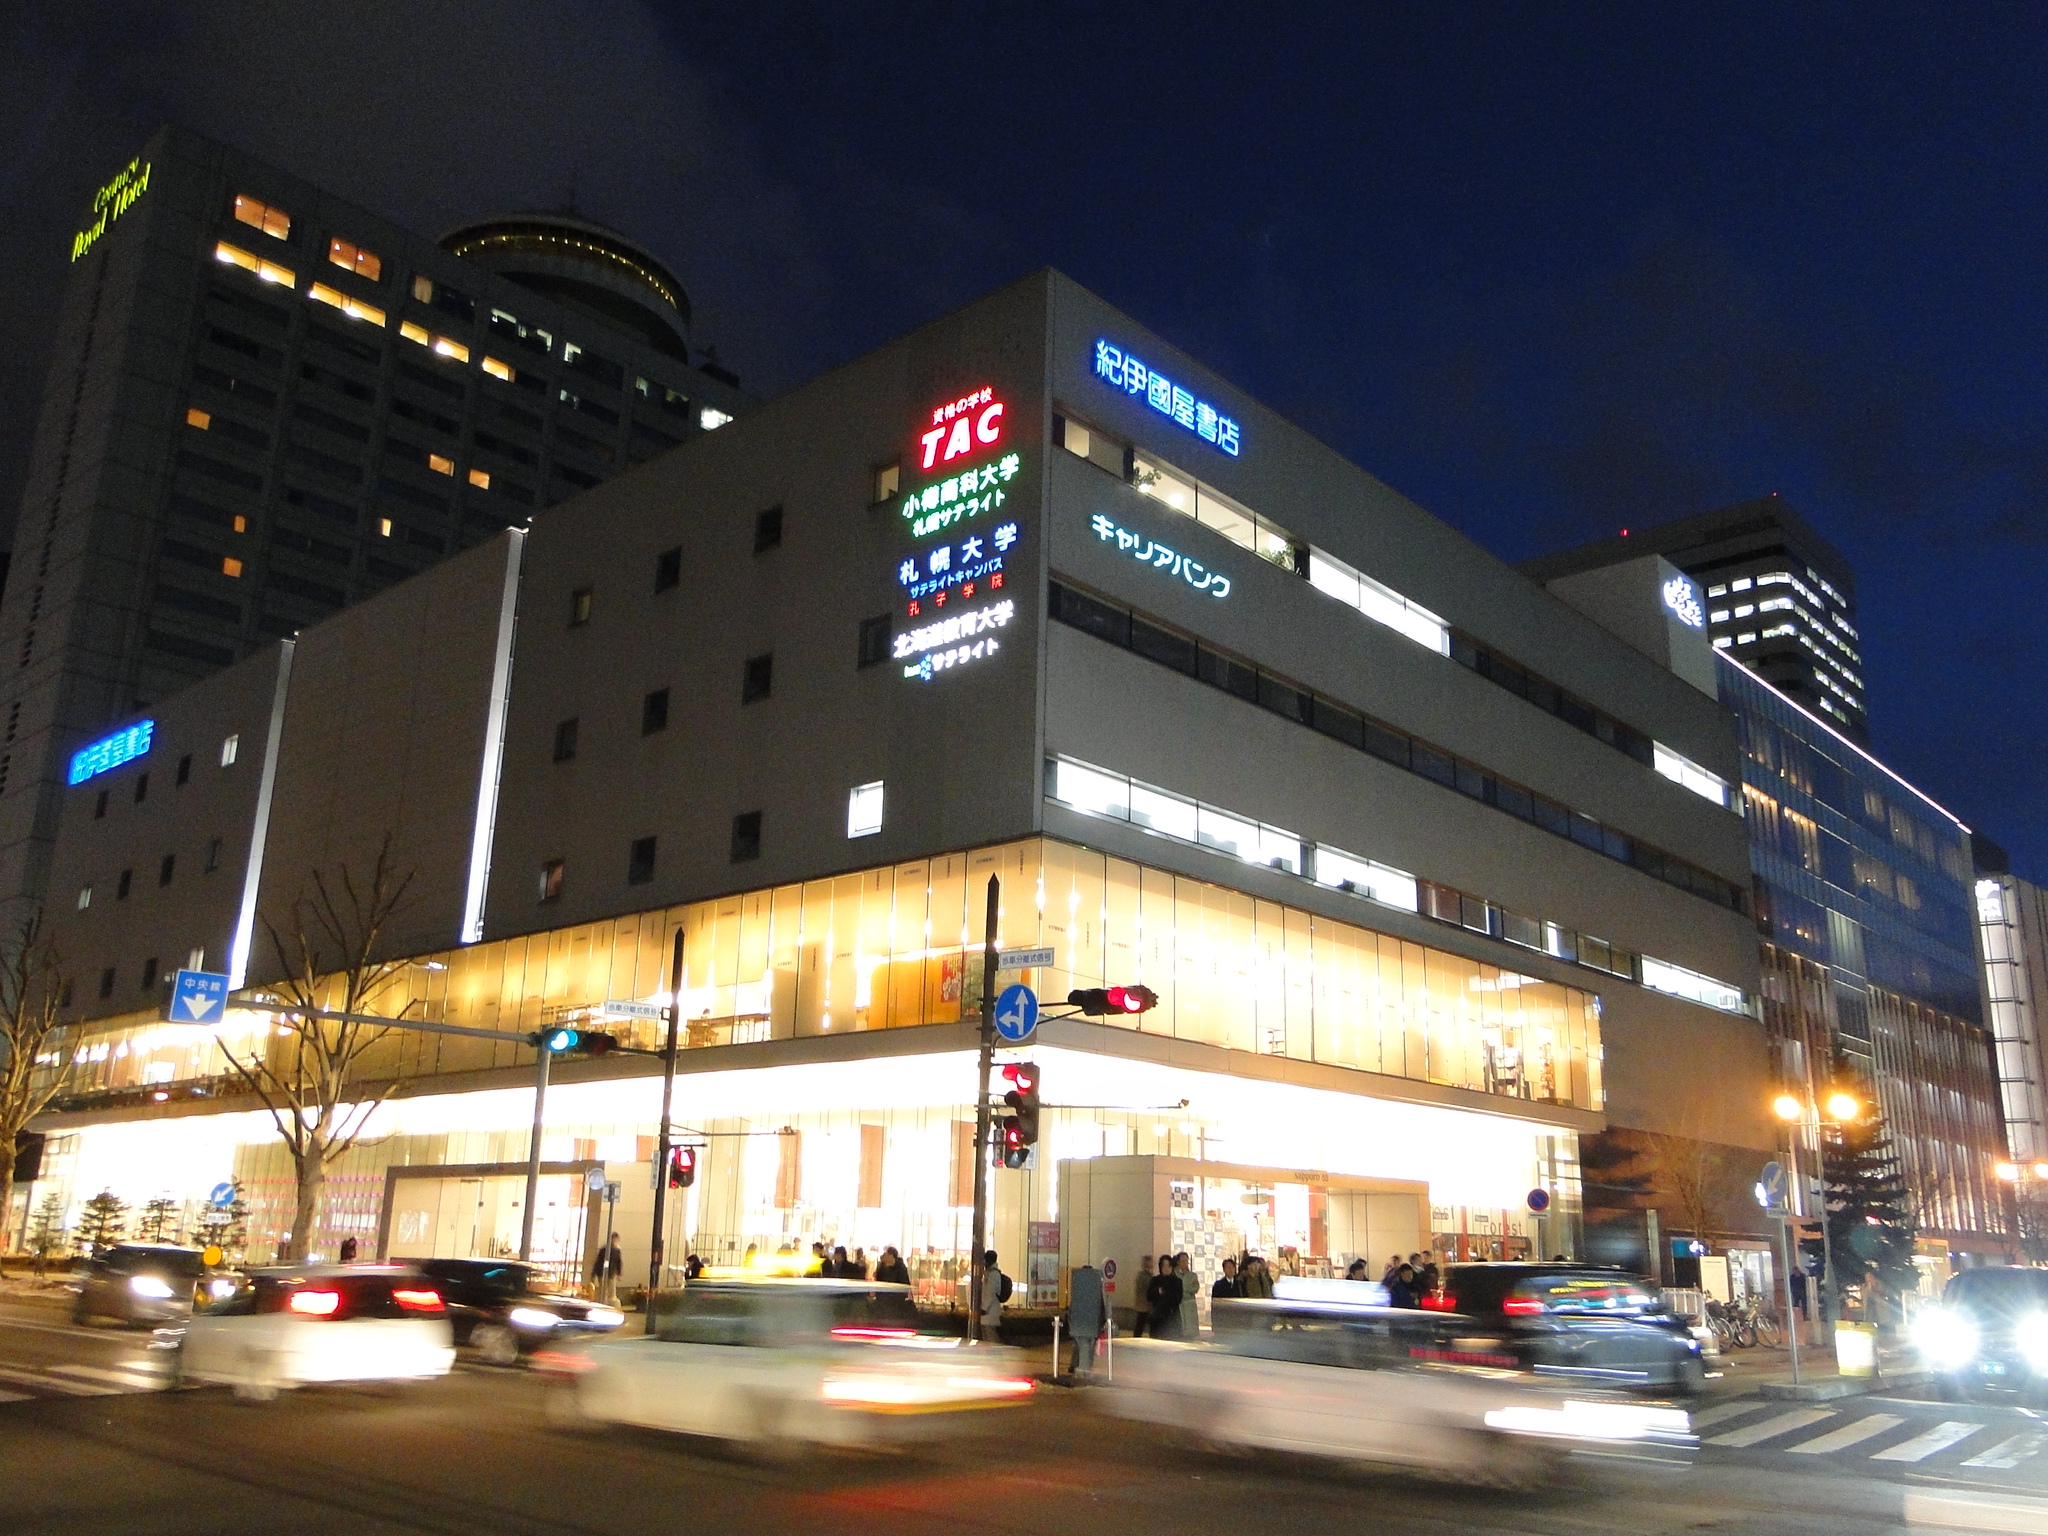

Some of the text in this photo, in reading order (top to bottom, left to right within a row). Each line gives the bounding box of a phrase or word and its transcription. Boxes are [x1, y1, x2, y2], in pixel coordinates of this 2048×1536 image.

[71, 162, 150, 262] Royal Hotel
[932, 385, 993, 425] 資格の学校
[1096, 339, 1241, 457] 紀伊國屋書店
[920, 402, 1004, 470] TAC
[902, 452, 1020, 519] 小樽商科大学
[912, 488, 1006, 538] 札幌サテライト
[900, 522, 1018, 585] 札幌大学
[1092, 514, 1231, 599] キャリアバンク
[908, 573, 1004, 617] 孔子学院
[931, 637, 999, 671] サテライト
